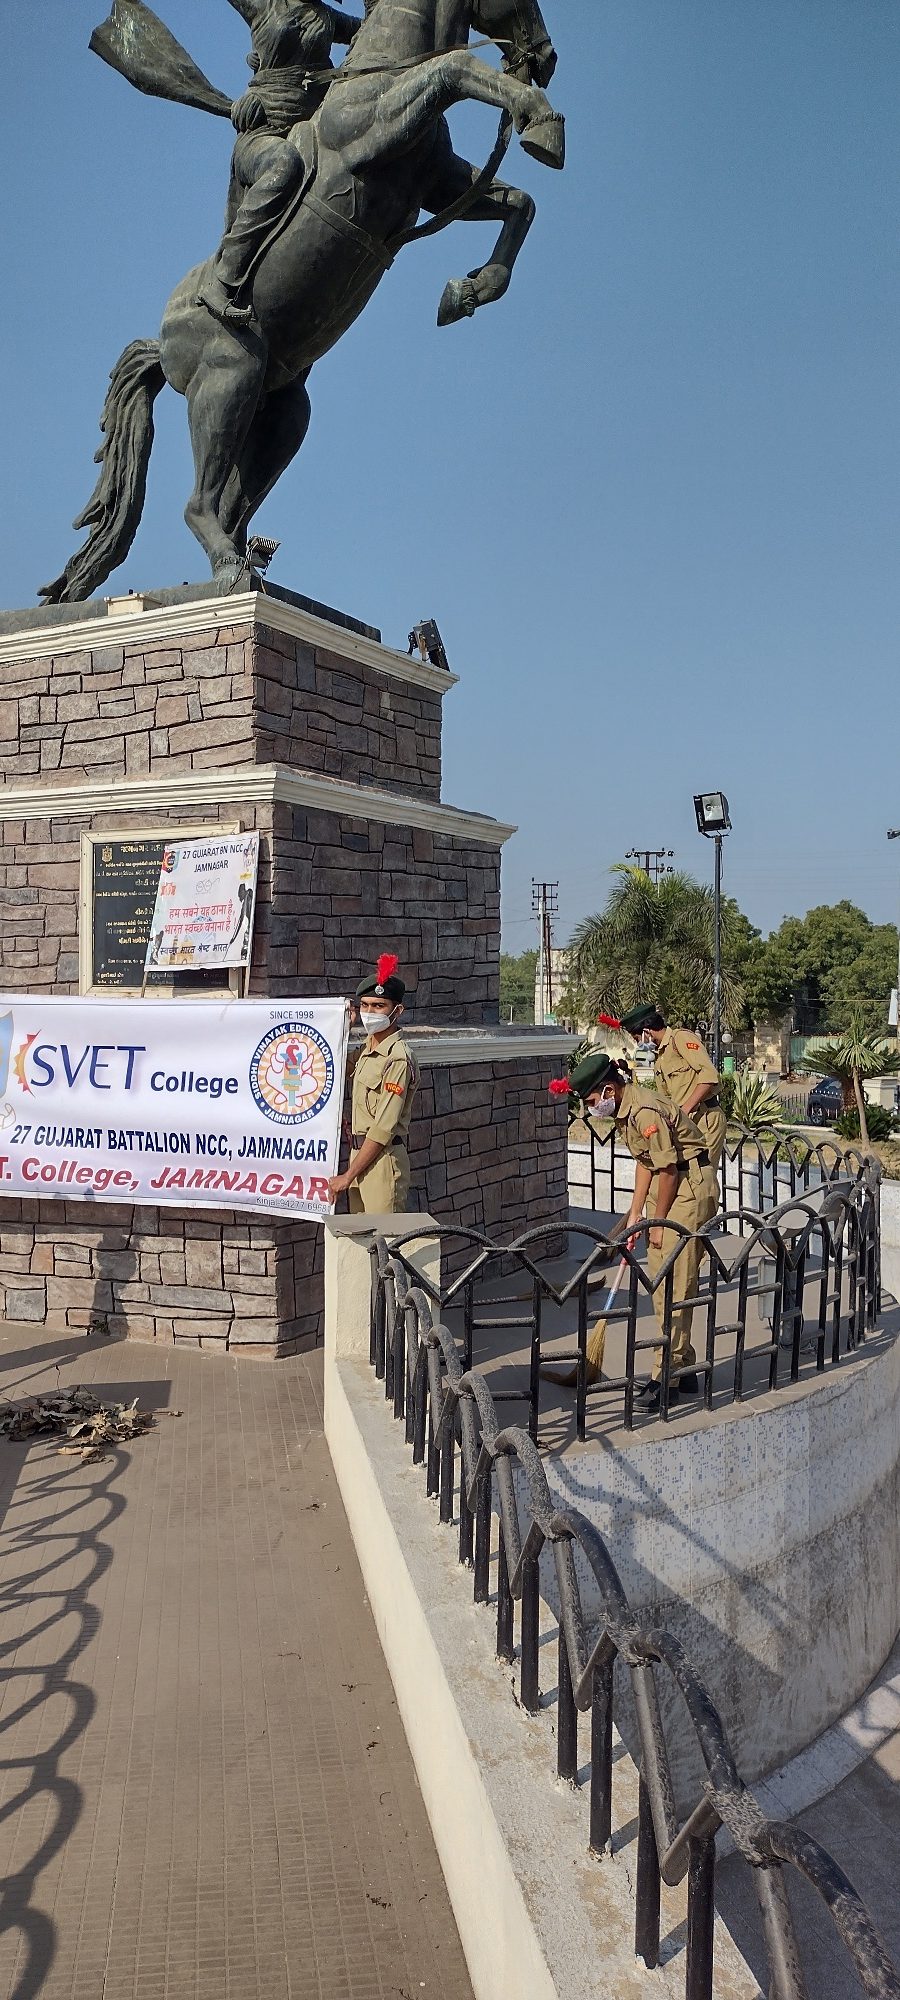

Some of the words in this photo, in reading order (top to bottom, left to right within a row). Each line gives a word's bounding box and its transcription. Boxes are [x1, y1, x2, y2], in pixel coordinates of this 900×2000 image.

[183, 850, 191, 860] 27
[192, 847, 220, 859] GUJARAT
[230, 844, 244, 854] NCC
[194, 860, 229, 873] JAMNAGAR
[169, 908, 181, 919] हम
[201, 906, 210, 917] यह
[165, 924, 183, 935] भारत
[213, 944, 228, 952] भारत
[269, 1011, 293, 1020] SINCE
[295, 1011, 314, 1020] 1998
[254, 1025, 287, 1061] VINAYAK
[289, 1024, 332, 1062] EDUCATION
[31, 1045, 146, 1090] SVET
[150, 1071, 239, 1098] College
[250, 1062, 262, 1100] SIDDHI
[320, 1064, 333, 1102] TRUST
[387, 1083, 401, 1093] NCC
[264, 1107, 315, 1124] JAMNAGAR
[10, 1125, 31, 1144] 27
[34, 1126, 102, 1149] GUJARAT
[107, 1130, 190, 1153] BATTALION
[196, 1134, 232, 1161] NCC,
[237, 1136, 328, 1162] JAMNAGAR
[22, 1157, 139, 1191] College,
[151, 1167, 330, 1203] JAMNAGAR
